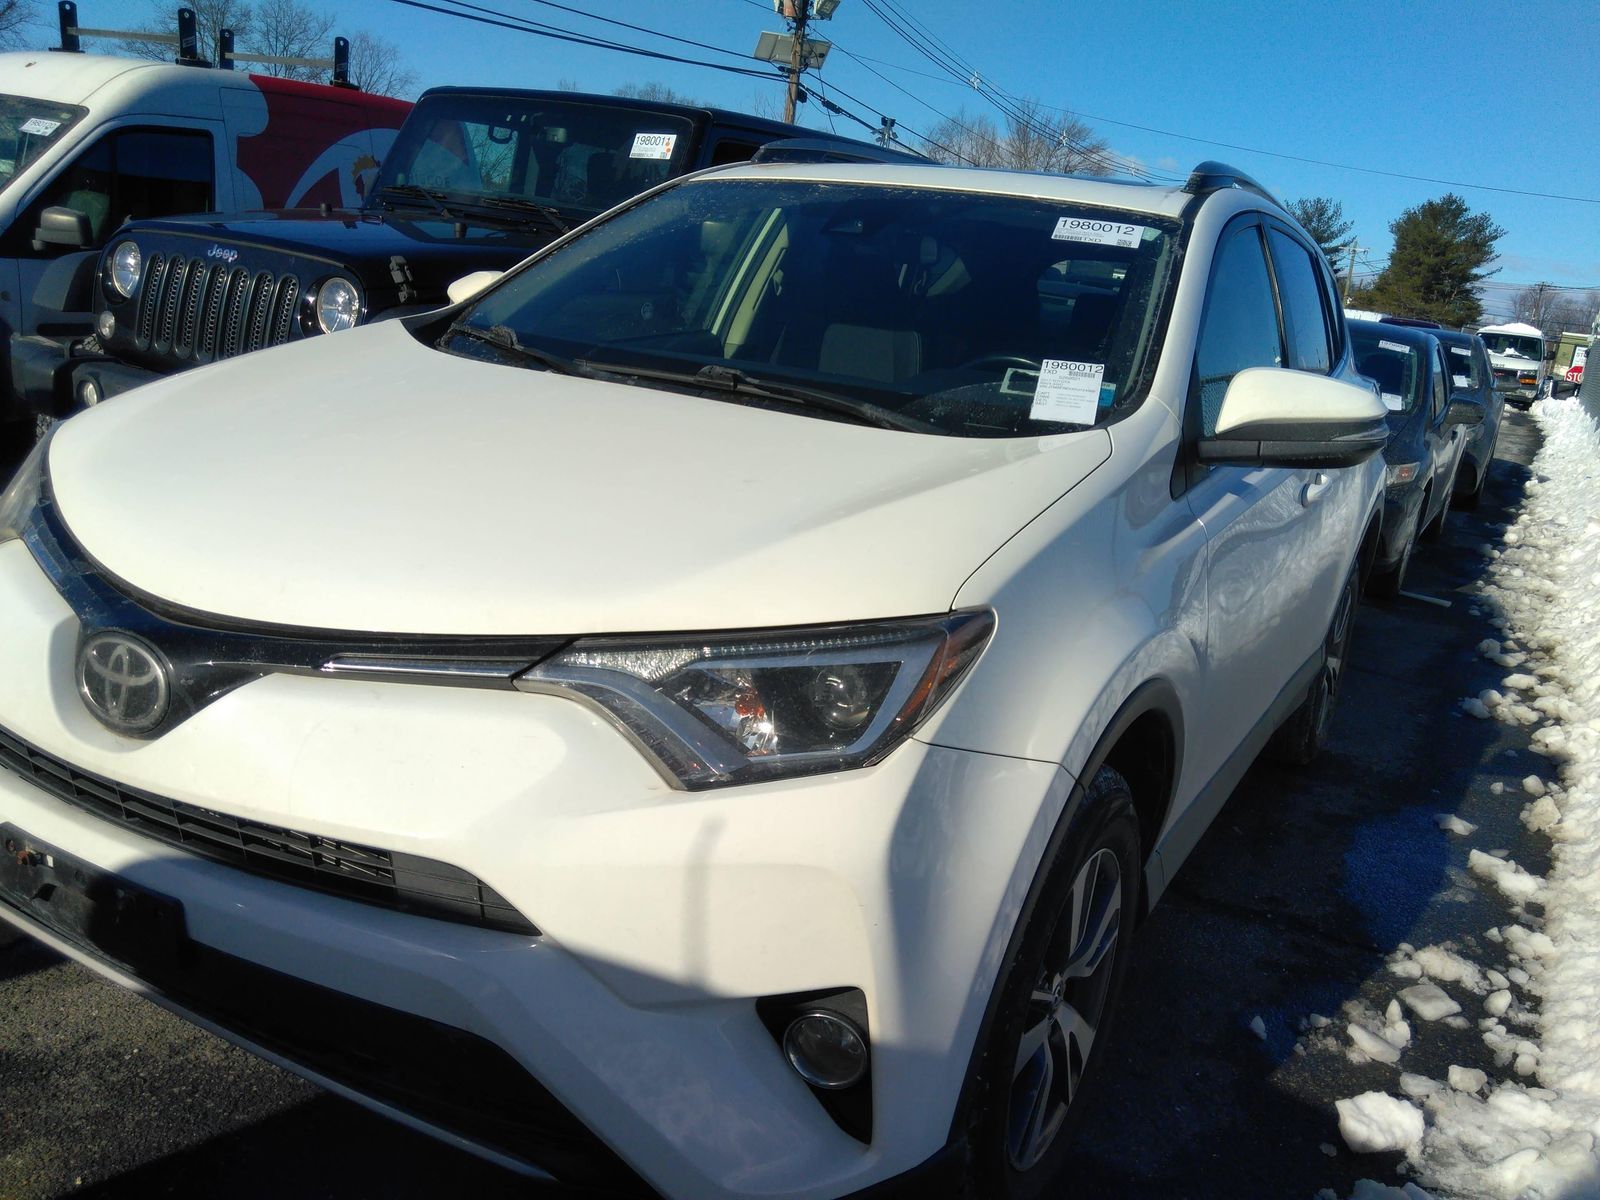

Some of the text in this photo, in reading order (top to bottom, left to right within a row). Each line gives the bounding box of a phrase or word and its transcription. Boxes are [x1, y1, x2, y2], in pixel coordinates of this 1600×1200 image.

[1061, 219, 1135, 236] 1980012
[207, 244, 238, 263] Jeep
[1044, 361, 1104, 374] 1980012
[1566, 372, 1583, 382] STO
